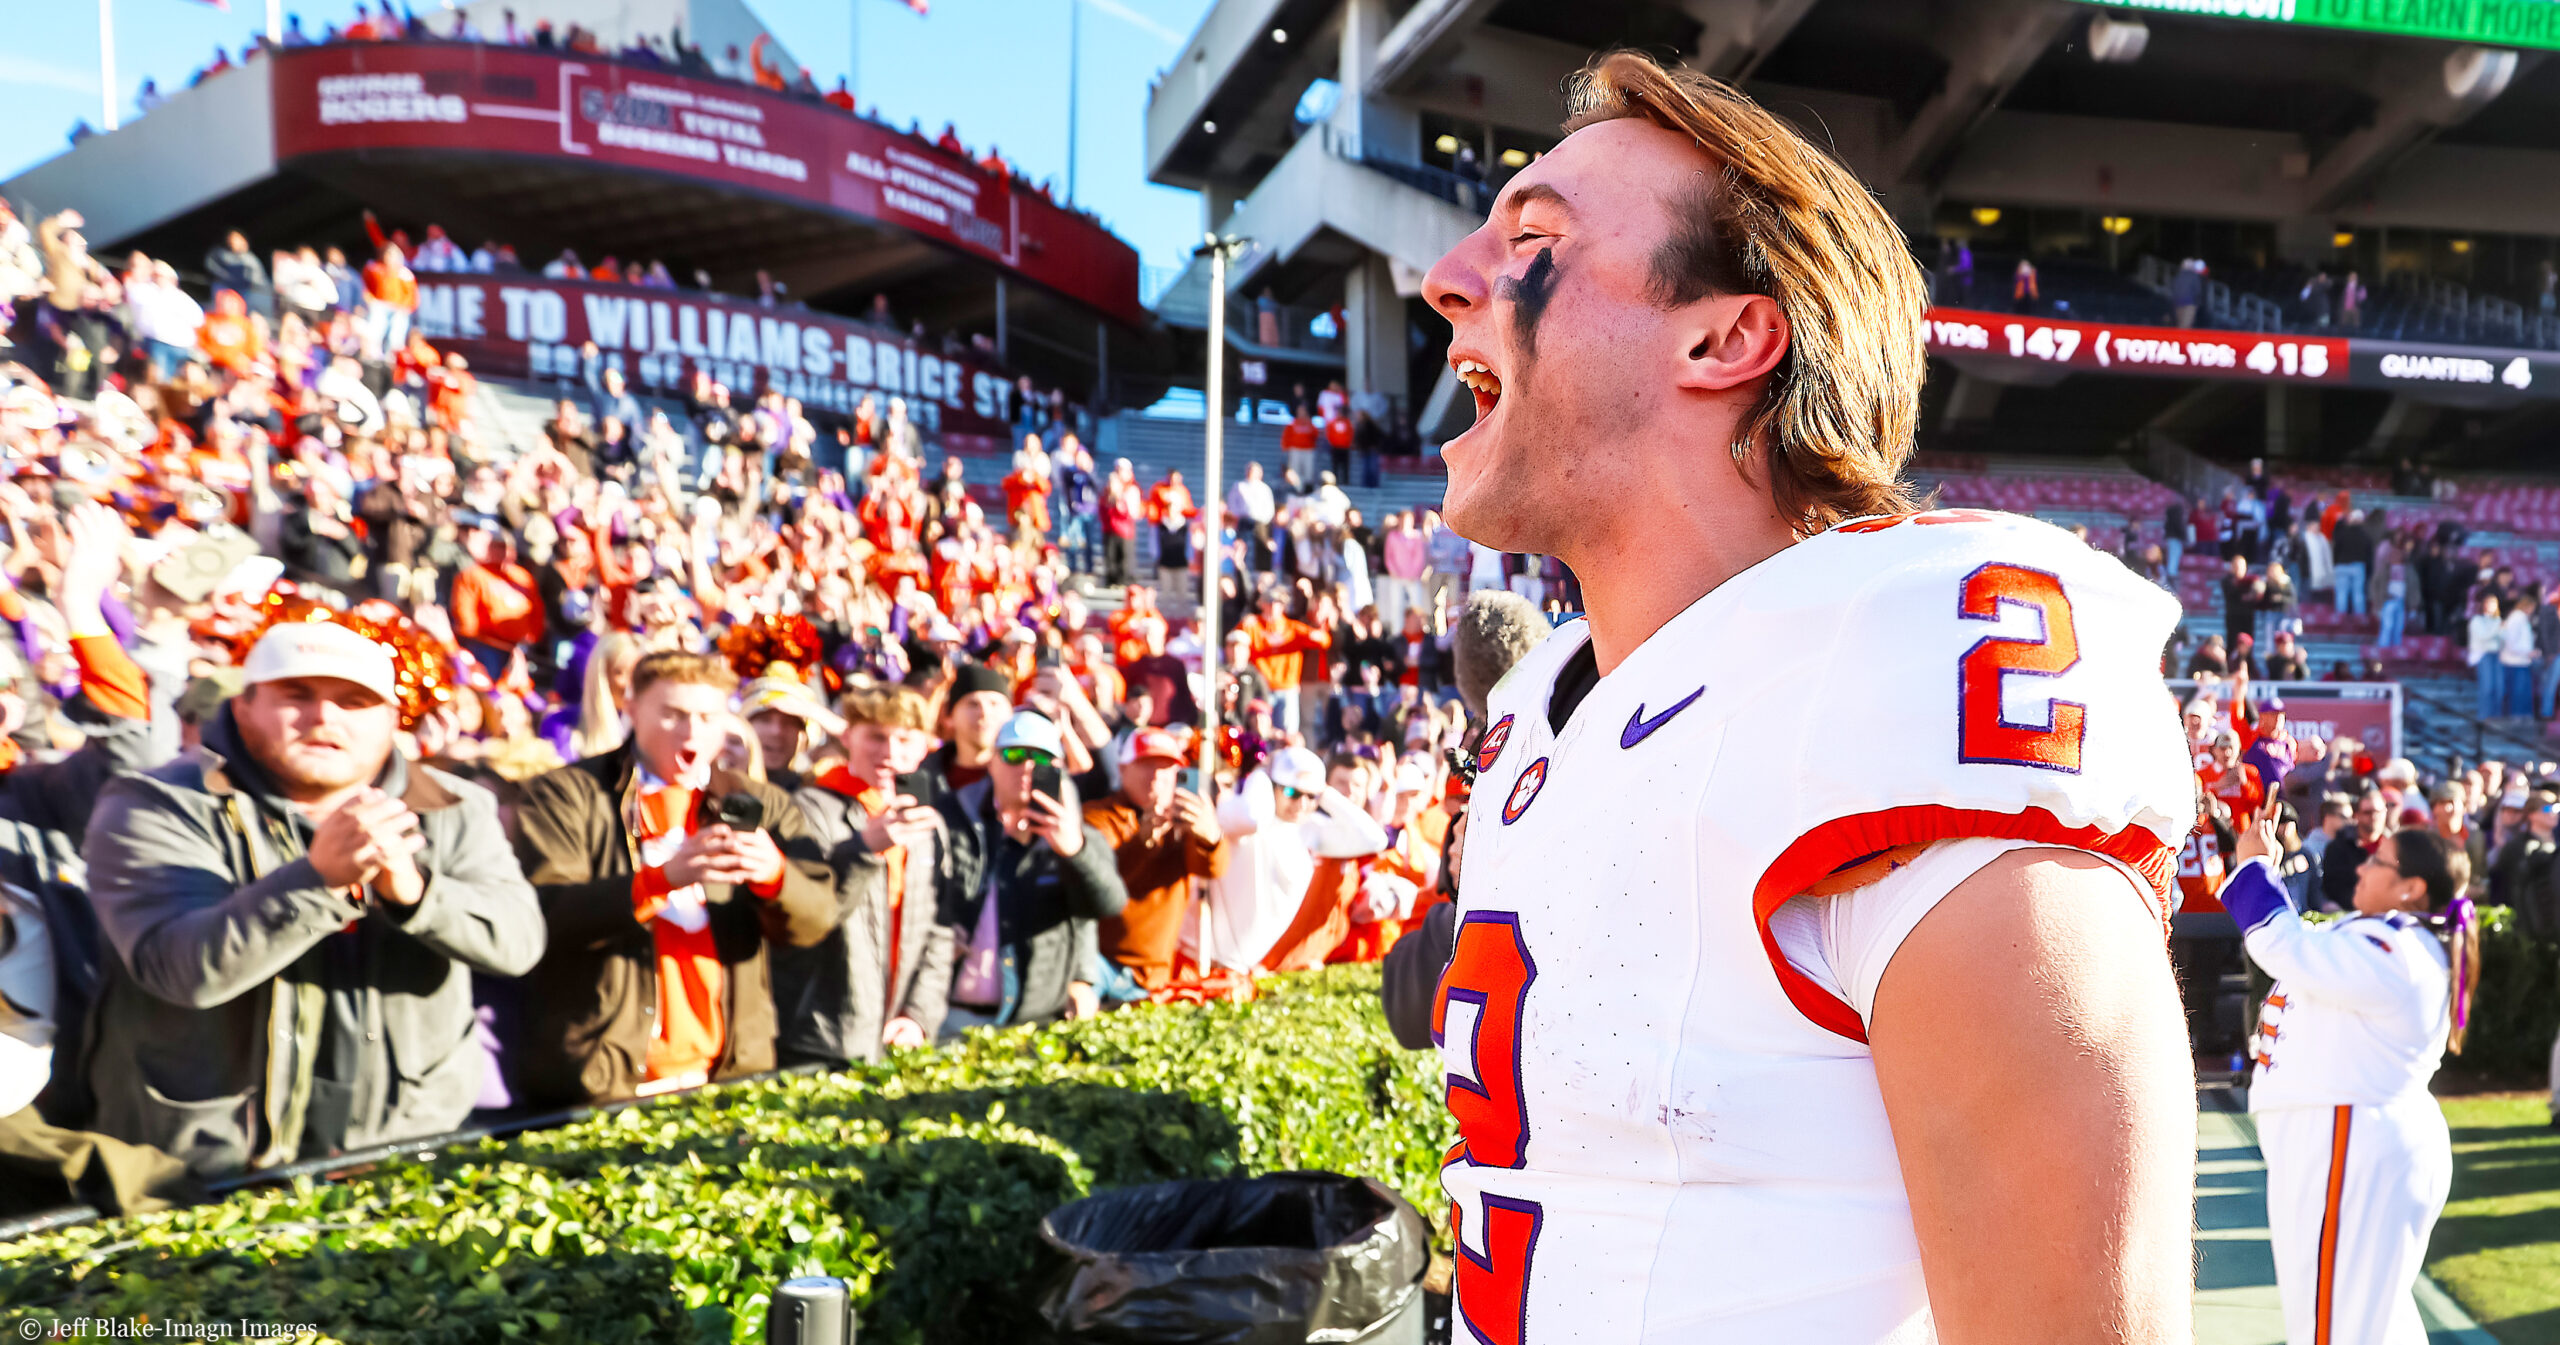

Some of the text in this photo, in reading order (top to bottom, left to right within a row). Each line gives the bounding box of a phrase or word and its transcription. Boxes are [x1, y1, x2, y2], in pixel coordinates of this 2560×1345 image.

[500, 286, 568, 343] TO
[582, 292, 965, 409] WILLIAMS-BRICE
[2004, 323, 2082, 362] 147
[2113, 338, 2187, 366] TOTAL
[2245, 341, 2329, 377] 415
[2379, 353, 2533, 390] QUARTER: 4
[1957, 560, 2087, 776] 2
